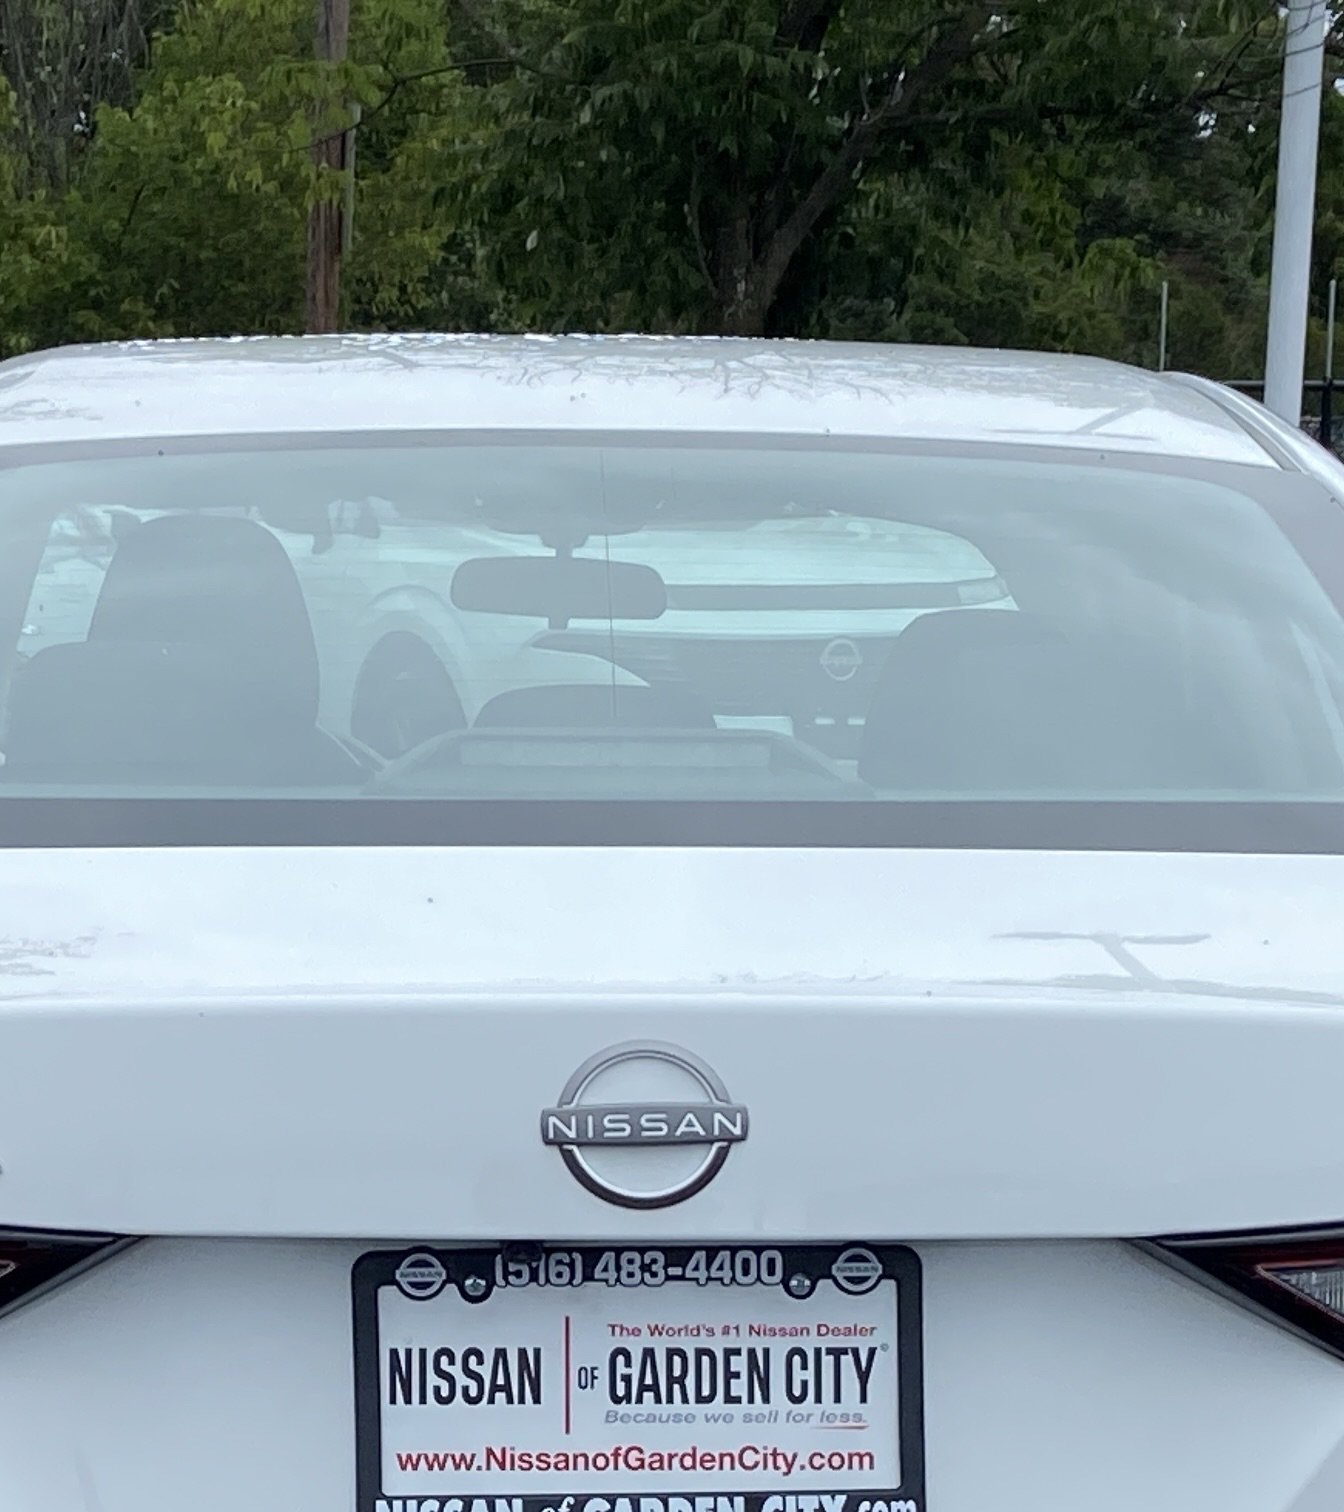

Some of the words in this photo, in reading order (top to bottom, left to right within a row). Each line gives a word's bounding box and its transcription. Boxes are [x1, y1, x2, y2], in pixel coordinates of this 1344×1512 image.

[548, 1112, 743, 1139] NISSAN
[494, 1252, 583, 1288] (516)
[594, 1250, 783, 1288] 483-4400
[608, 1324, 642, 1338] The
[647, 1324, 716, 1338] World's
[721, 1324, 741, 1338] #1
[748, 1324, 810, 1338] Nissan
[816, 1324, 877, 1338] Dealer
[389, 1347, 542, 1405] NISSAN
[577, 1366, 599, 1390] OF
[608, 1346, 771, 1405] GARDEN
[785, 1346, 878, 1405] CITY
[604, 1410, 696, 1424] Because
[705, 1414, 734, 1424] we
[742, 1410, 778, 1424] sell
[785, 1410, 813, 1424] for
[819, 1410, 868, 1424] less.
[396, 1446, 875, 1477] www.NissanofGardenCity.com
